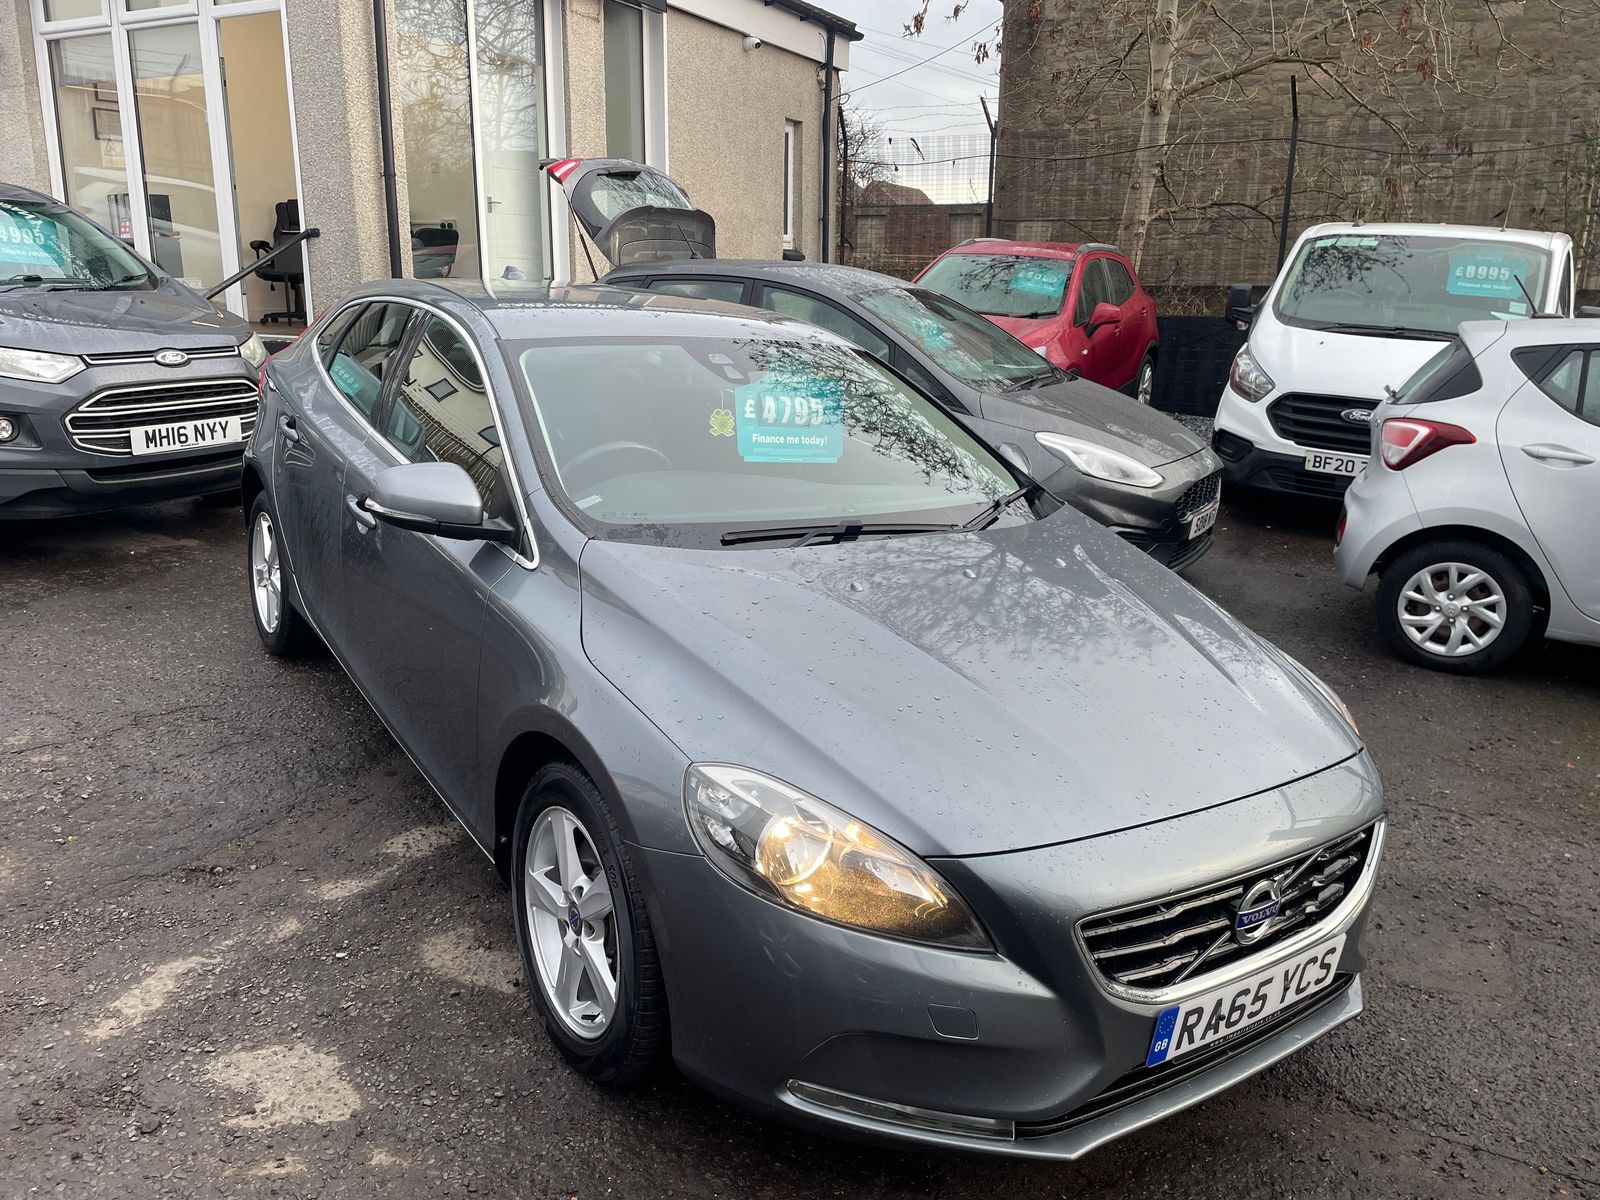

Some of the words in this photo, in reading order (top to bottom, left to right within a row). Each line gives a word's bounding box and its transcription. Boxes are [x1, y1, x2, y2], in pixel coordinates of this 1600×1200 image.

[762, 395, 824, 425] 4795
[1349, 410, 1374, 421] Ford
[145, 426, 188, 449] MH16
[194, 420, 229, 442] NYY
[752, 433, 785, 444] Finance
[786, 435, 800, 444] me
[801, 434, 828, 447] today!
[1312, 455, 1355, 473] BF20
[1241, 904, 1279, 924] VOLVO
[1175, 976, 1273, 1051] RA65
[1280, 946, 1337, 1004] YCS
[1154, 1038, 1169, 1052] GB
